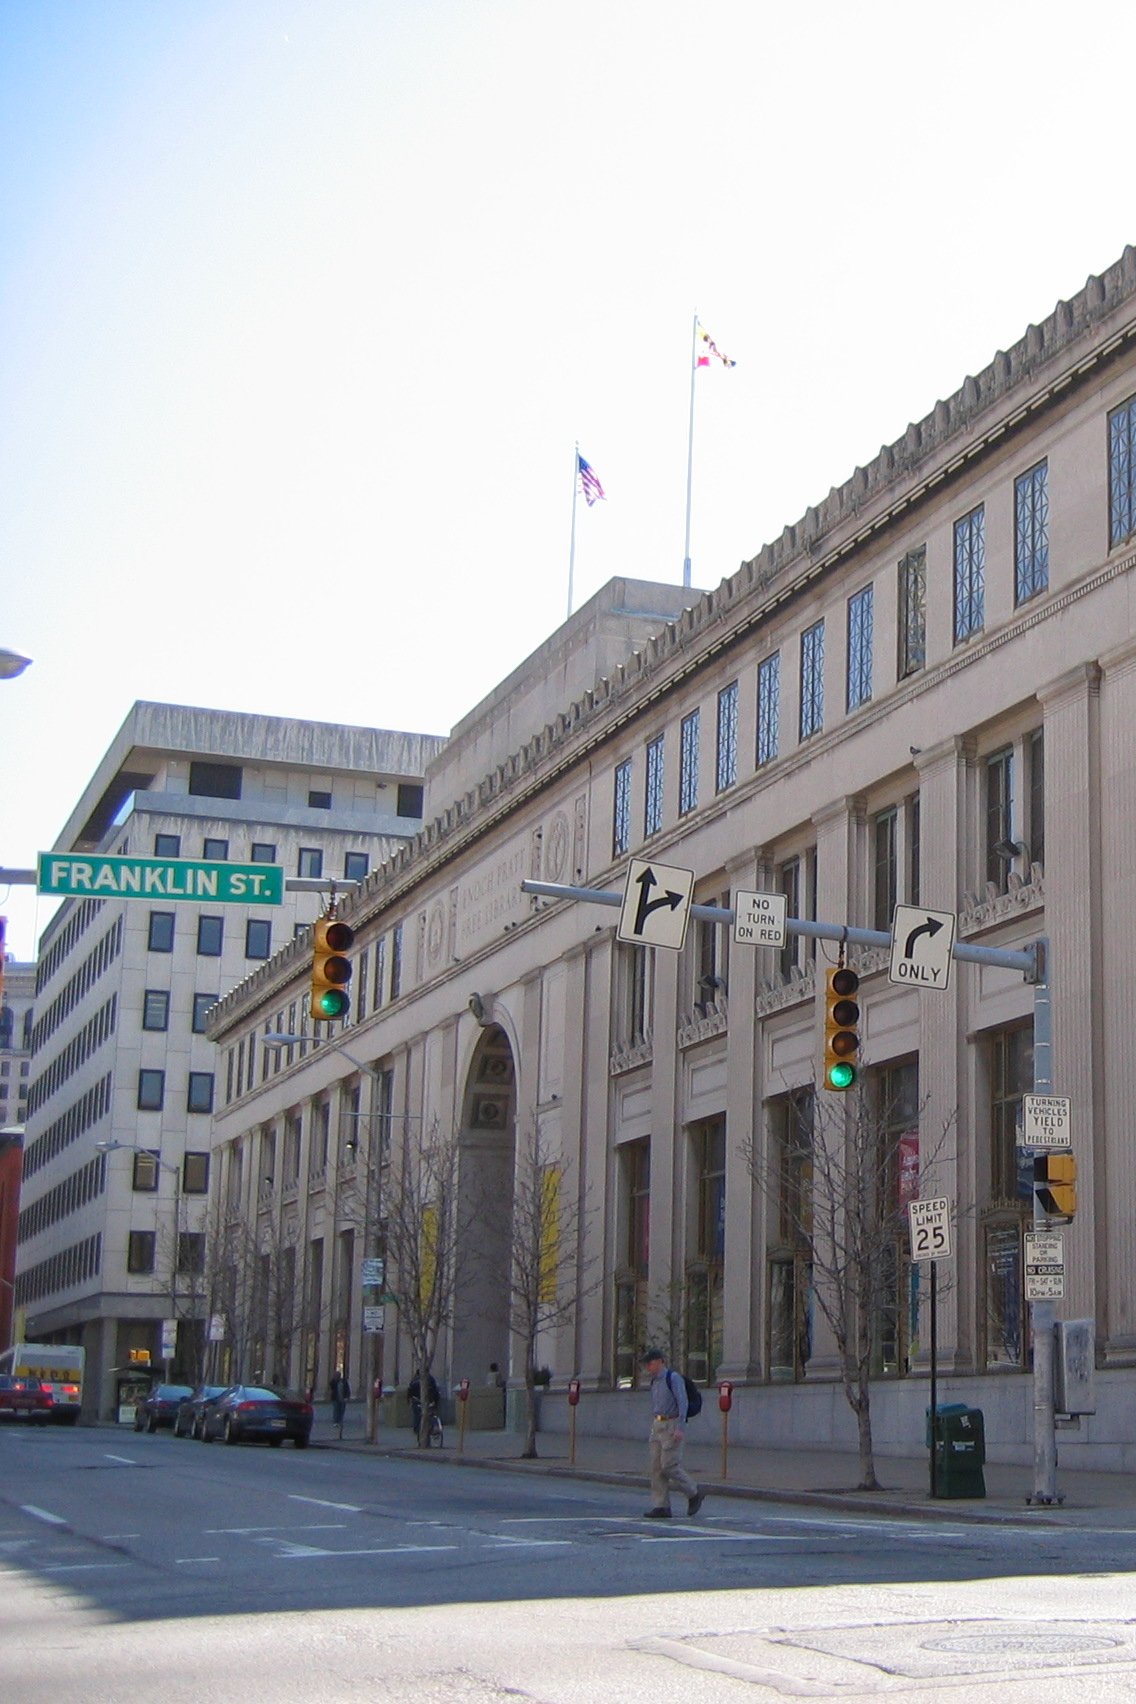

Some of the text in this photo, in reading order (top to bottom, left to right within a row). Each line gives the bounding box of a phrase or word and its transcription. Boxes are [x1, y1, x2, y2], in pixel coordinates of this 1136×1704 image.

[50, 861, 272, 897] FRANKLIN ST.
[752, 898, 770, 910] NO
[747, 912, 775, 926] TURN
[738, 926, 782, 941] ON RED
[898, 963, 941, 982] ONLY
[1030, 1097, 1067, 1107] TURNING
[1028, 1107, 1068, 1117] VEHICLES
[1033, 1116, 1064, 1127] YIELD
[1042, 1127, 1054, 1135] TO
[1028, 1135, 1069, 1145] PEDESTRIANS
[912, 1200, 946, 1214] SPEED
[916, 1213, 942, 1226] LIMIT
[916, 1226, 945, 1251] 25
